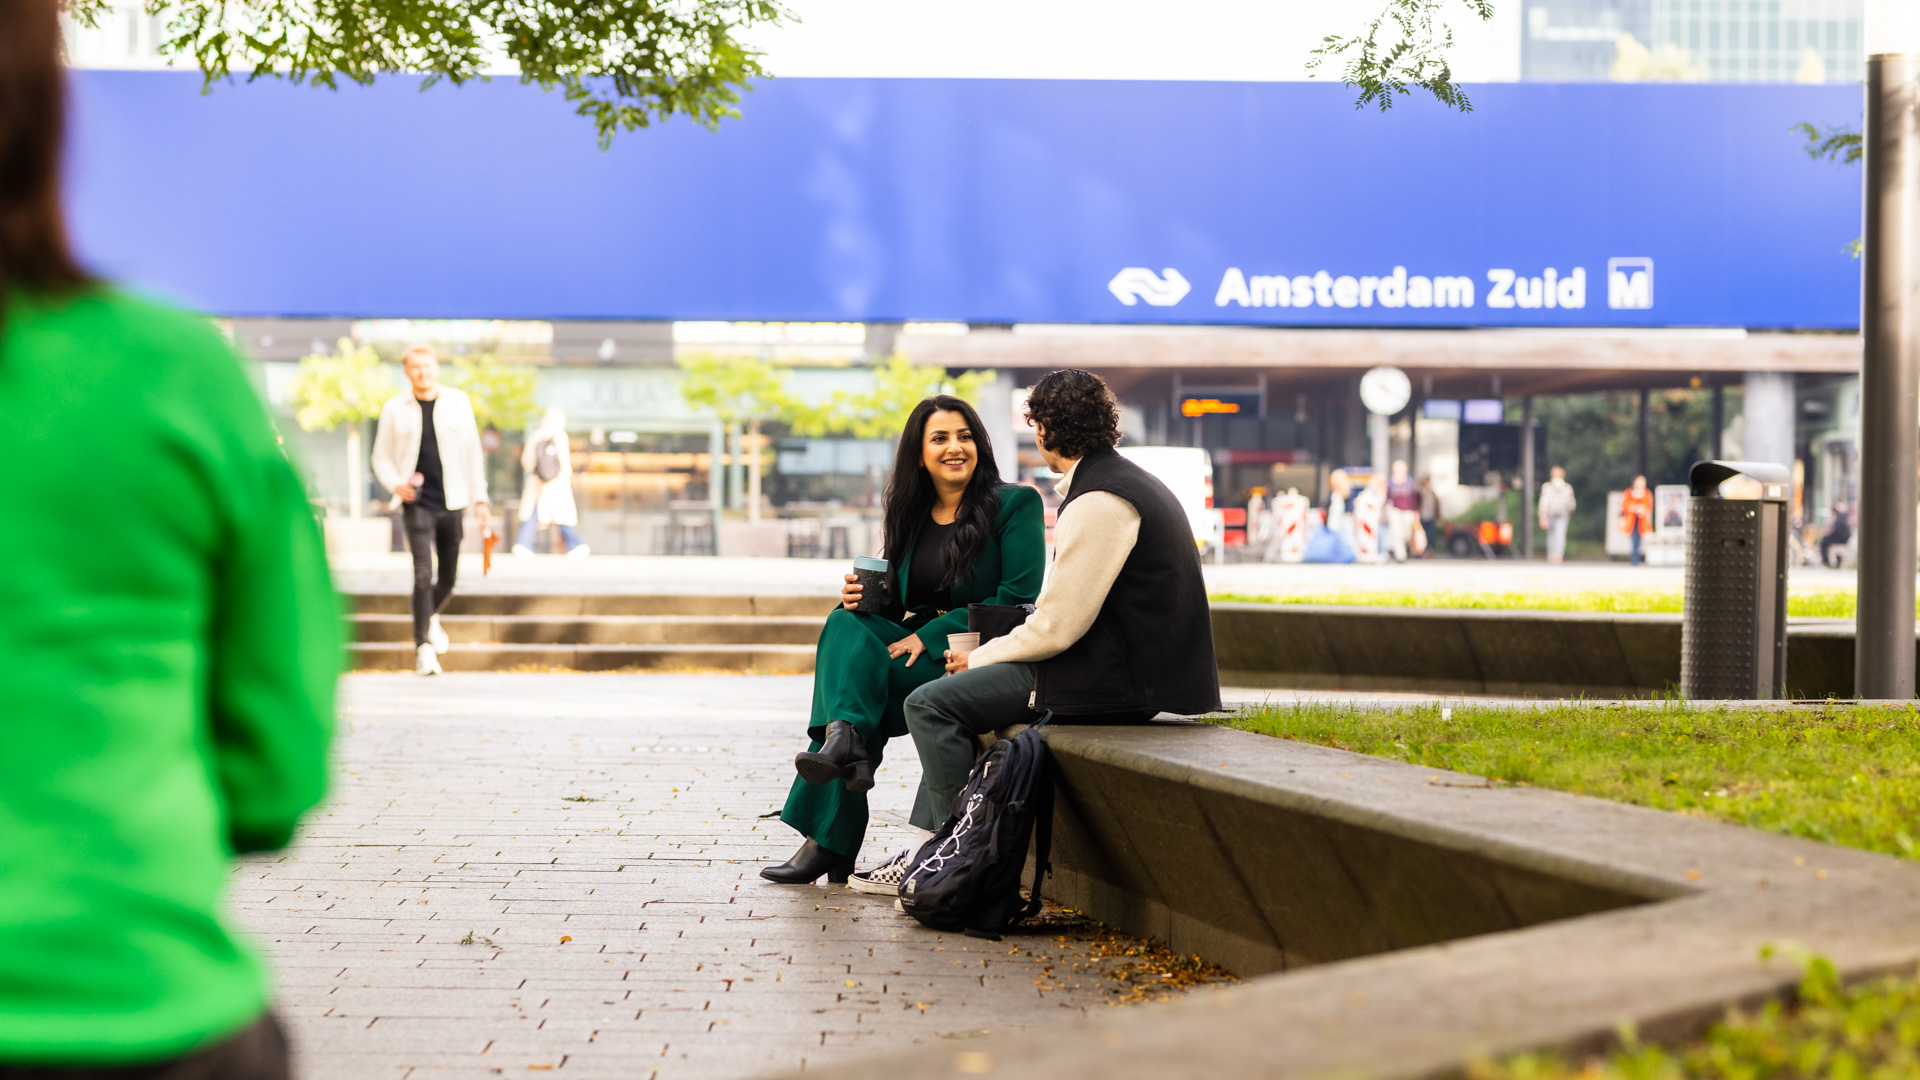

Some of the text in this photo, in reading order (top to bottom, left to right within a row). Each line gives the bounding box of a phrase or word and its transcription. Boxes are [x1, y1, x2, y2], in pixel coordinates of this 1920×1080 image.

[1214, 265, 1651, 309] Amsterdam Zuid M
